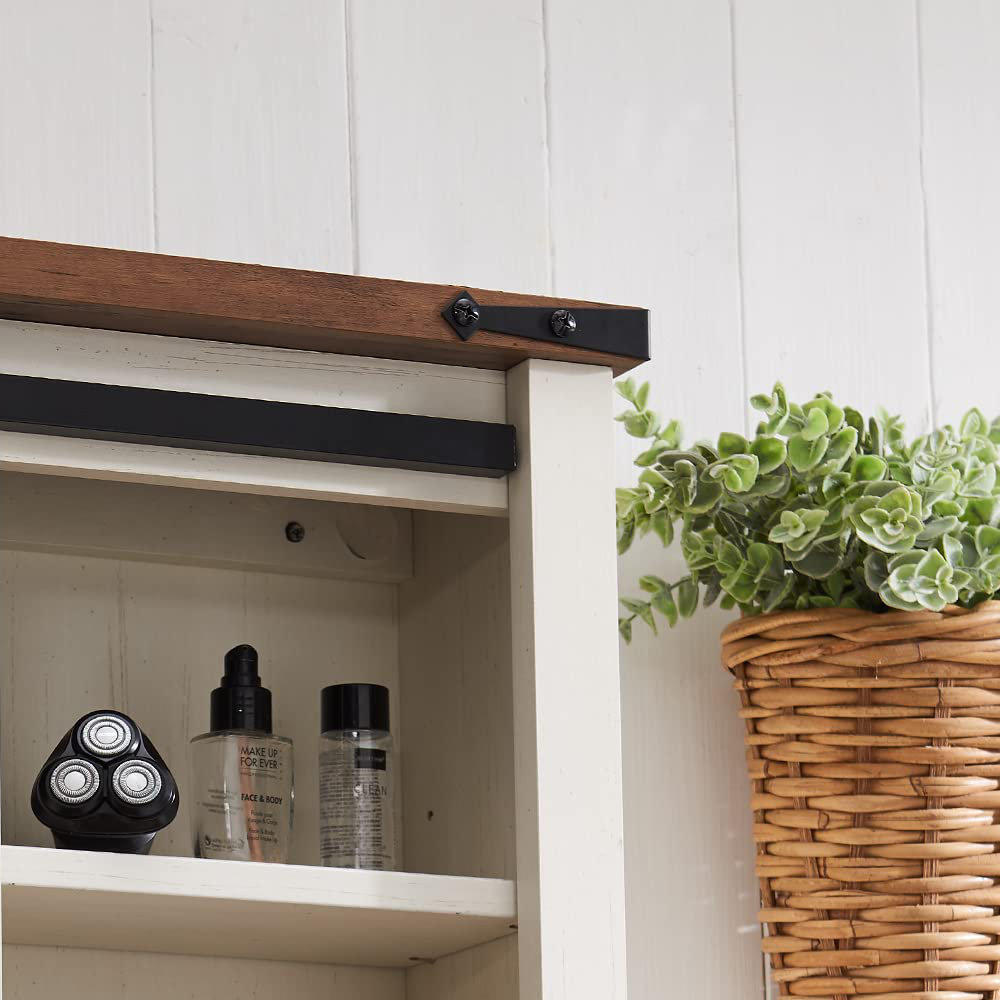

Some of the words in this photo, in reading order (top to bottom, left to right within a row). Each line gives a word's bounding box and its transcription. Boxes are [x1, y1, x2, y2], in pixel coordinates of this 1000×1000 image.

[240, 746, 266, 757] MAKE
[268, 748, 278, 758] UP
[240, 756, 258, 767] FOR
[259, 758, 278, 769] EVER
[241, 793, 258, 803] FACE
[265, 795, 283, 805] BODY
